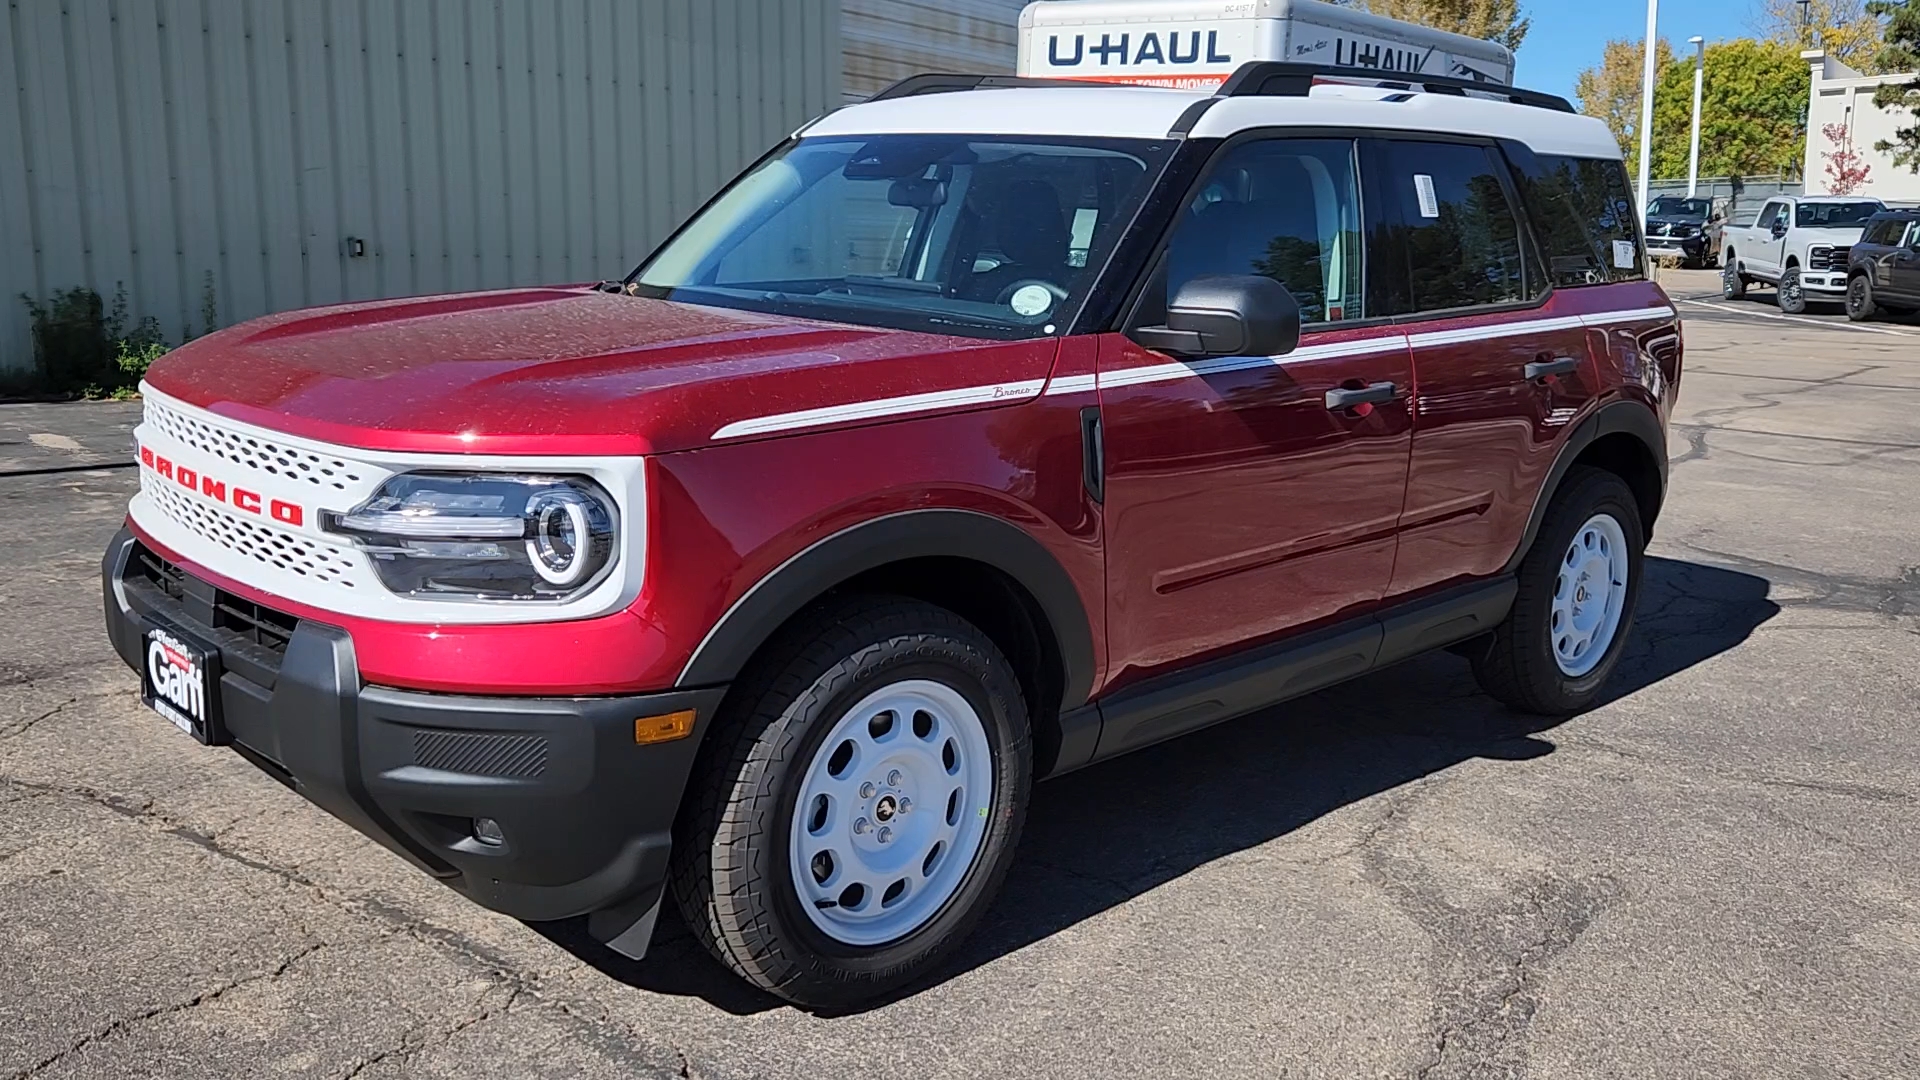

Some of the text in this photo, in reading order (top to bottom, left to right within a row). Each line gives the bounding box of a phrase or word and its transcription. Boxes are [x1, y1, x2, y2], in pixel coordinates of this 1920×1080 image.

[1048, 30, 1232, 66] U-HAUL
[992, 386, 1032, 398] Bronco
[140, 446, 303, 527] BRONCO
